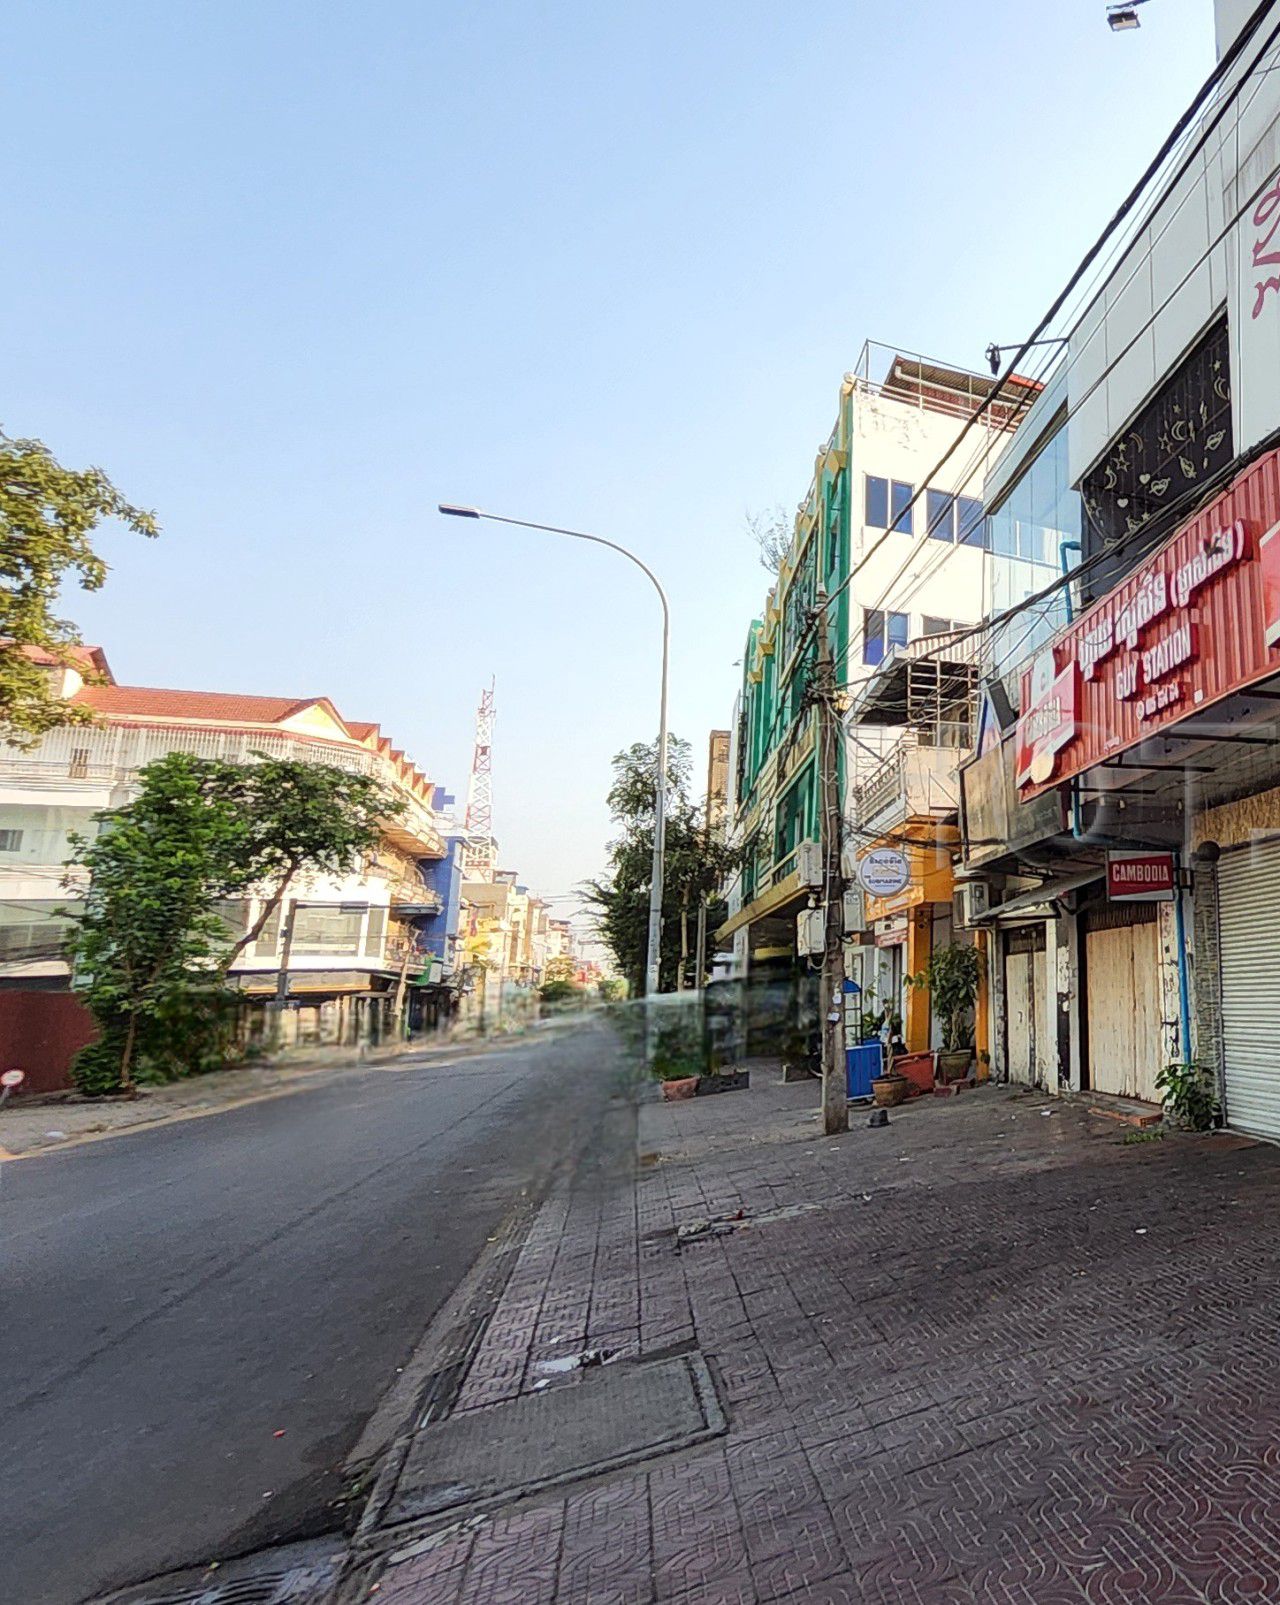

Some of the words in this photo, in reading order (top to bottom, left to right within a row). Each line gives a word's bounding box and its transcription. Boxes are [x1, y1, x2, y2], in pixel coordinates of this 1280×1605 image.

[1116, 658, 1137, 700] GUY
[1142, 622, 1191, 684] STATION
[1112, 864, 1169, 882] CAMBODIA
